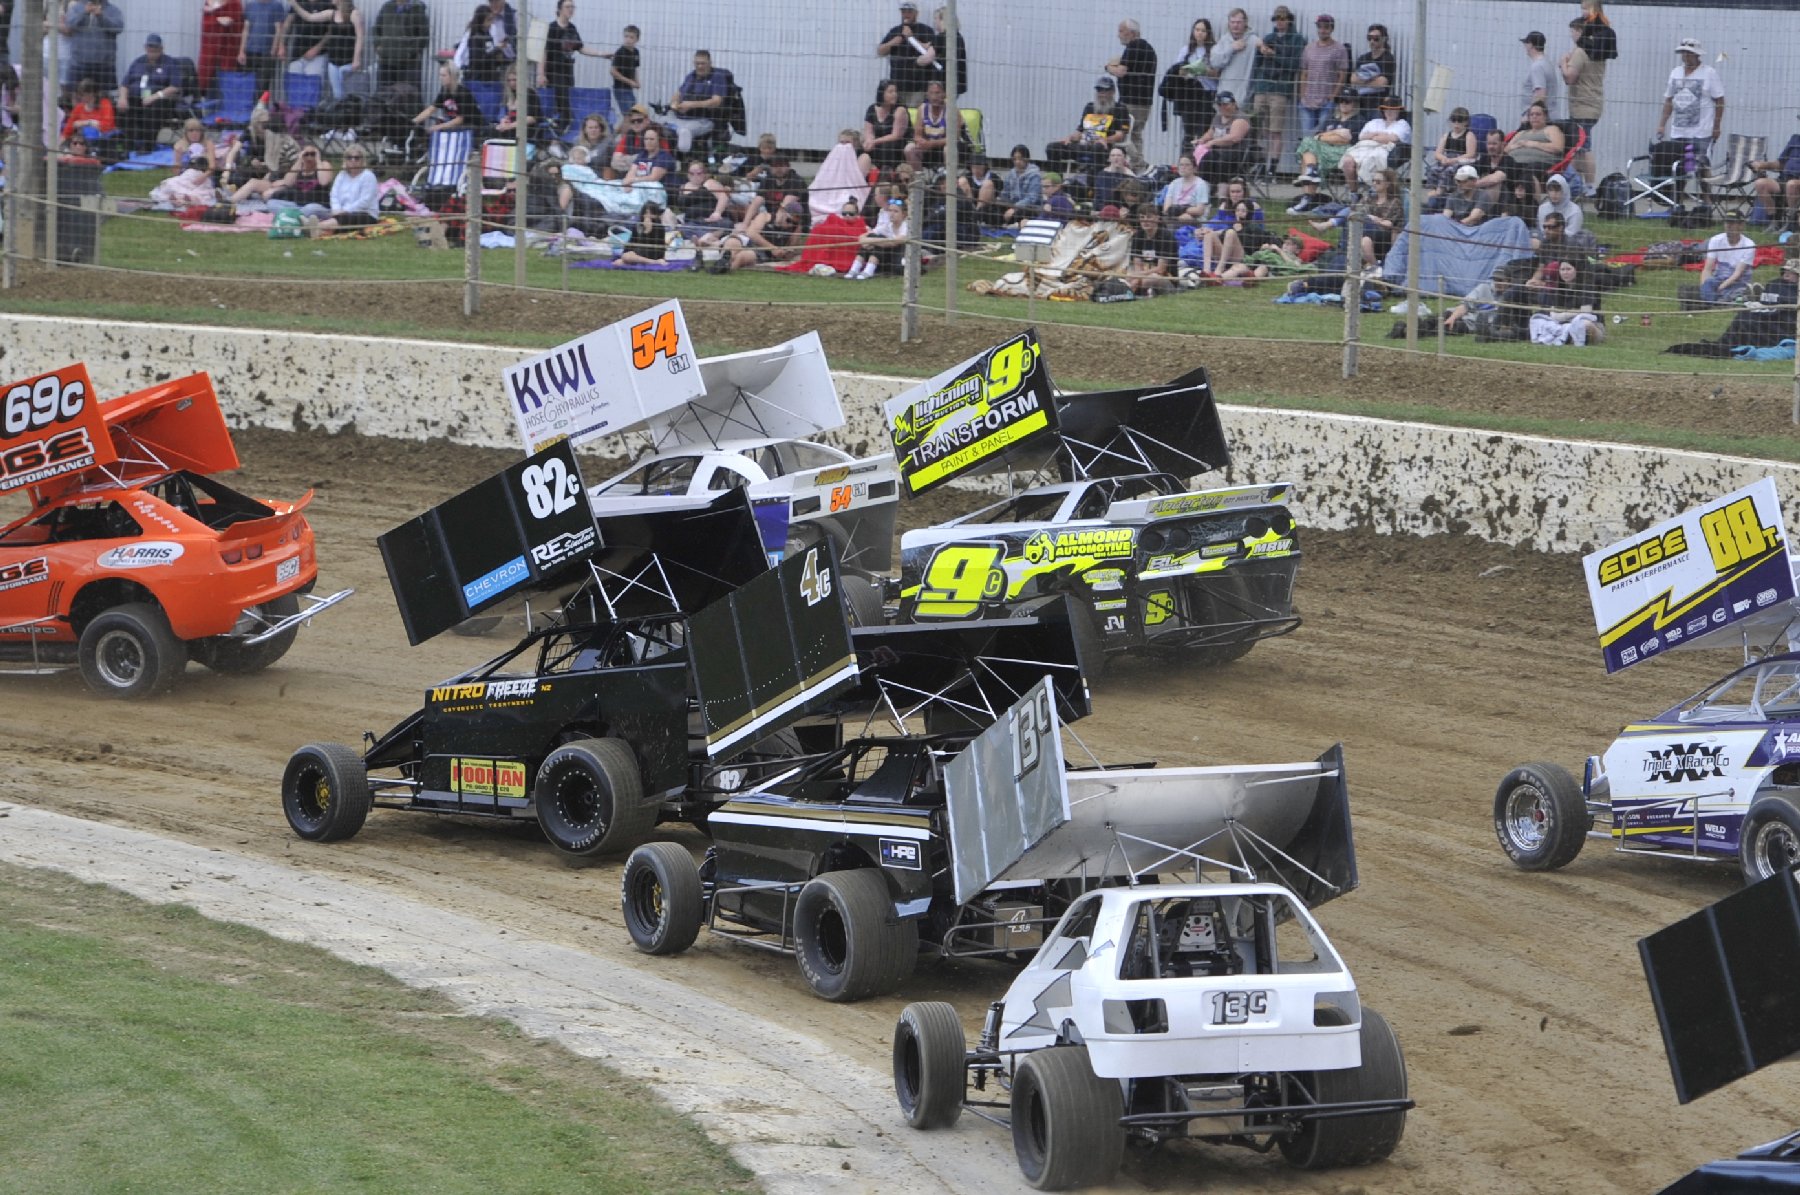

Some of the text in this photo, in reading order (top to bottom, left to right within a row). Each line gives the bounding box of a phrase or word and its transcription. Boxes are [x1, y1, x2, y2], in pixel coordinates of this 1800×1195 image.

[630, 310, 679, 370] 54
[511, 342, 597, 415] KIWI
[908, 389, 1039, 467] TRANSFORM
[0, 427, 95, 479] GE
[0, 456, 96, 491] ERFORMANCE
[830, 485, 852, 512] 54
[1055, 541, 1131, 557] AUTOMOTIVE
[1057, 529, 1133, 547] ALMOND
[111, 548, 173, 558] HARRIS
[1598, 525, 1689, 588] EDGE
[465, 559, 526, 598] CHEVRON
[1611, 578, 1634, 592] PARTS
[431, 682, 486, 702] NITRO
[486, 678, 538, 700] FREEZE
[1643, 758, 1672, 773] Triple
[1717, 753, 1731, 767] Co
[720, 770, 741, 790] 82
[1704, 823, 1727, 834] WELD
